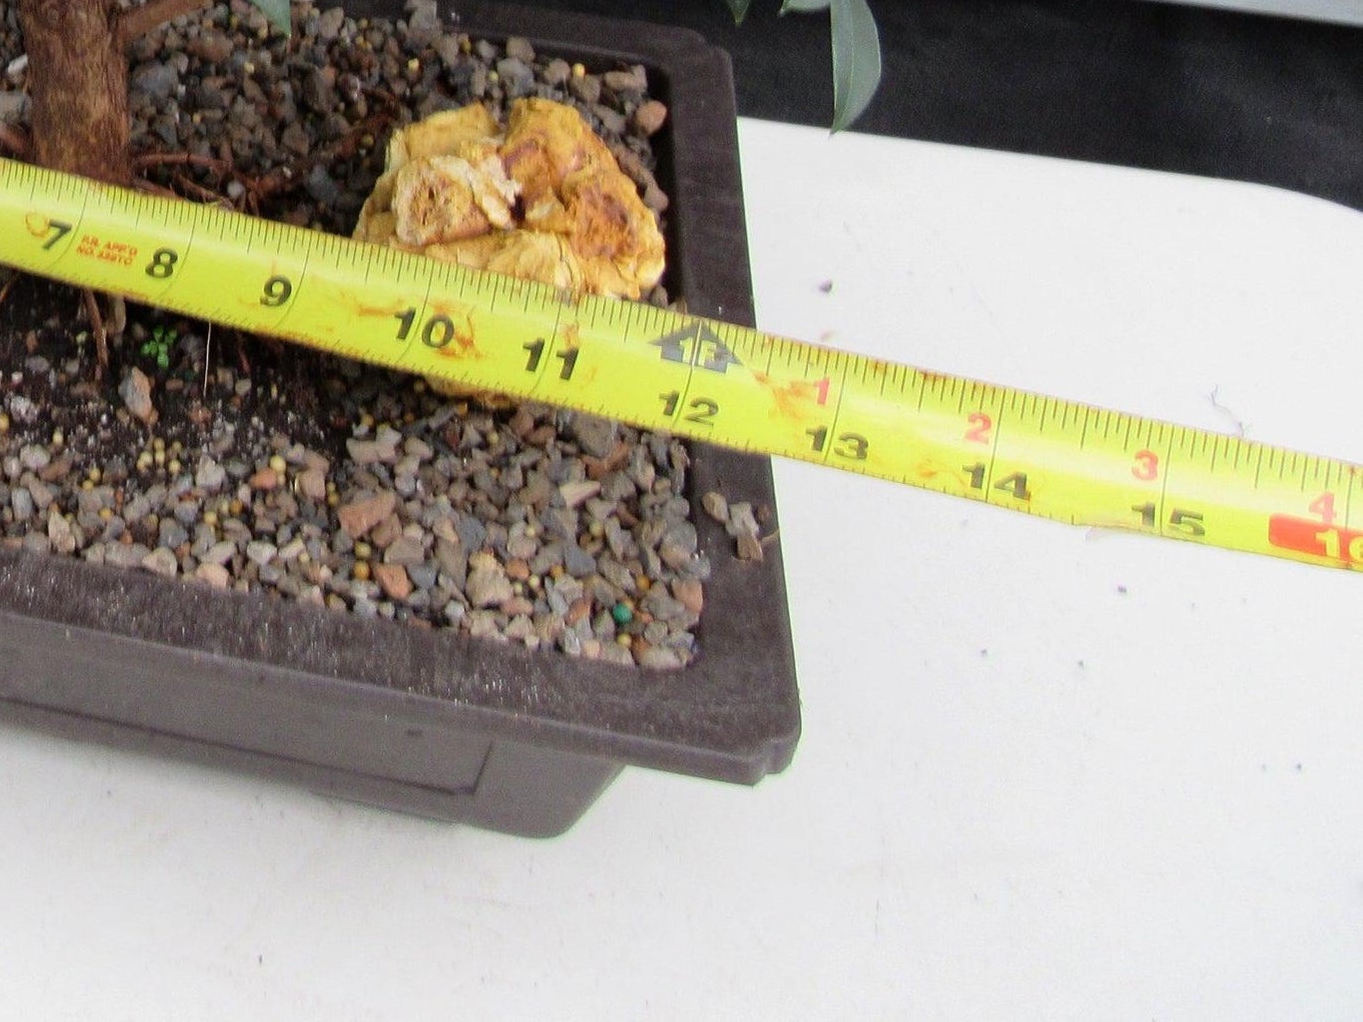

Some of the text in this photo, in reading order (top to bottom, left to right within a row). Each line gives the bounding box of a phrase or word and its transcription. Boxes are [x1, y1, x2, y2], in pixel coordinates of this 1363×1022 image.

[42, 219, 72, 250] 7
[145, 247, 179, 278] 8
[259, 275, 292, 307] 9
[395, 308, 455, 349] 10
[522, 338, 580, 381] 11
[658, 389, 720, 426] 12
[812, 377, 831, 405] 1
[805, 424, 870, 460] 13
[964, 412, 992, 444] 2
[962, 461, 1031, 500] 14
[1132, 450, 1159, 481] 3
[1131, 501, 1206, 537] 15
[1308, 490, 1337, 524] 4
